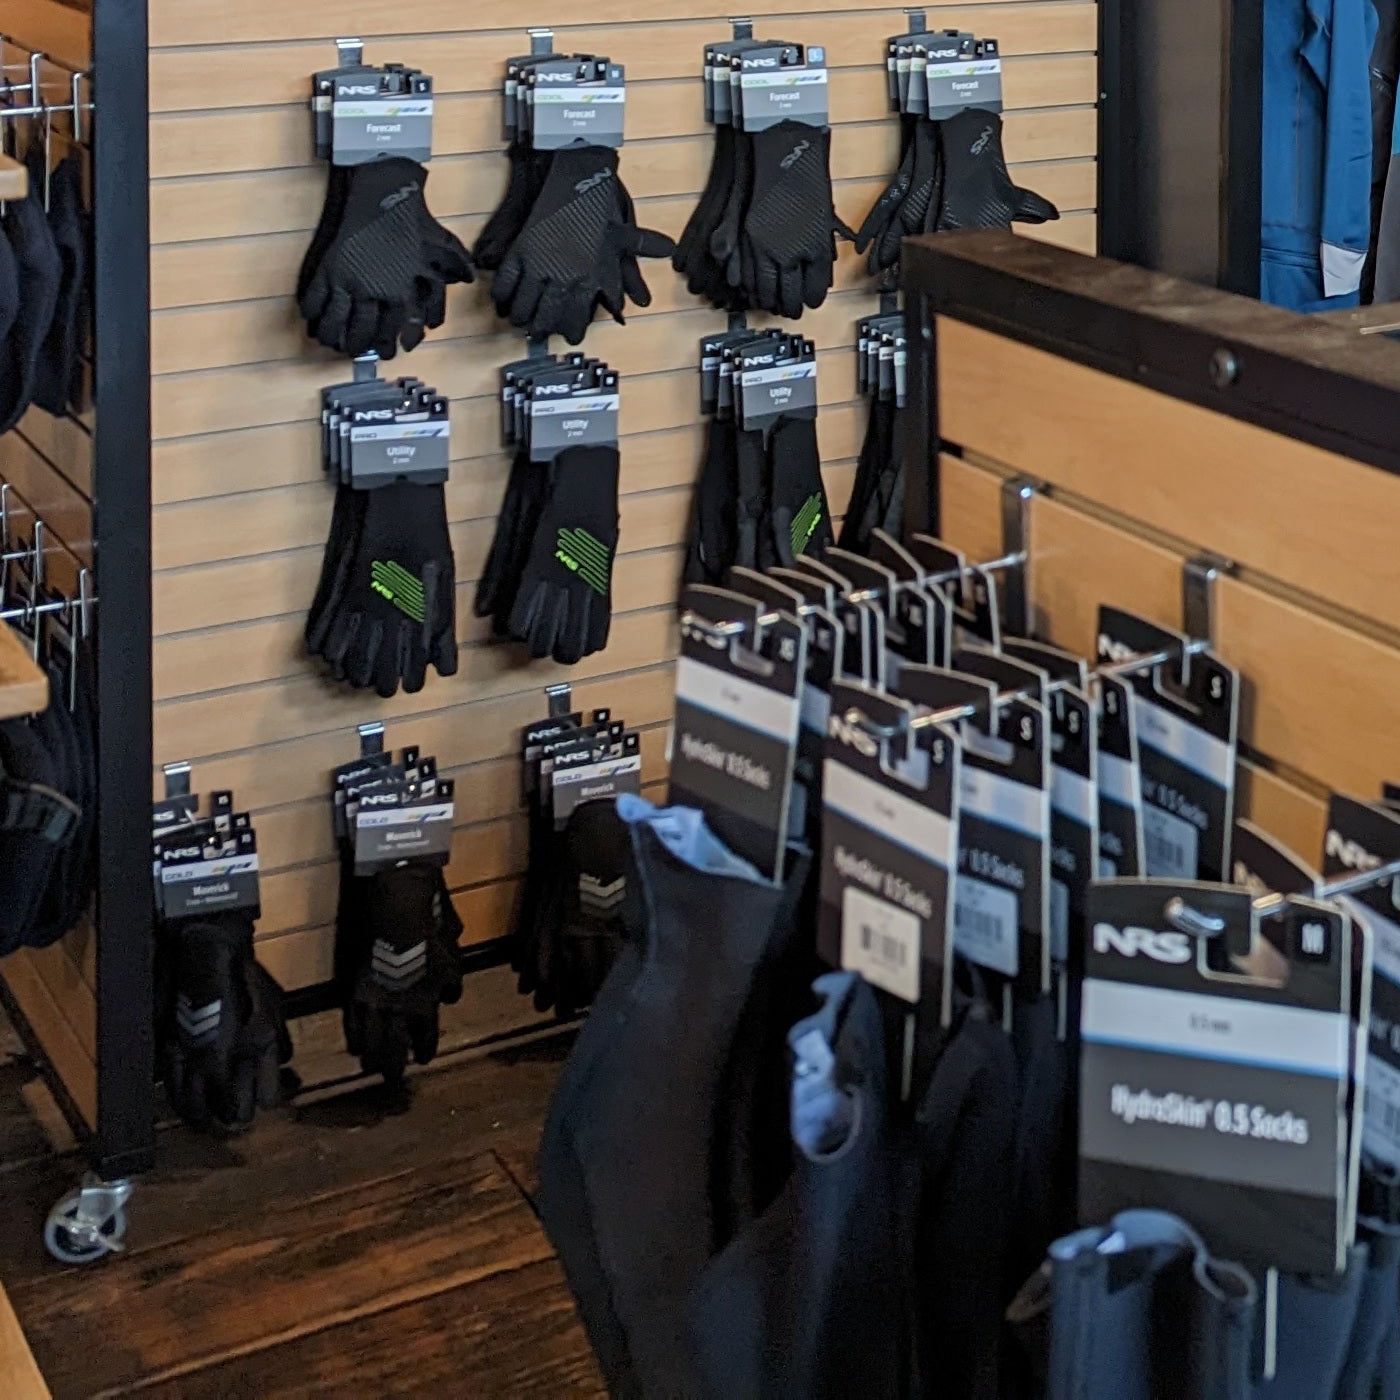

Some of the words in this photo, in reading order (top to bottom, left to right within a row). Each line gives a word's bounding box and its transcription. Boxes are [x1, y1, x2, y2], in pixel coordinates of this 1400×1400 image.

[928, 48, 957, 59] NRS
[743, 57, 776, 68] NRS
[536, 72, 574, 82] NRS
[338, 85, 377, 96] NRS
[952, 81, 979, 90] Forecast
[770, 92, 800, 102] Forecast
[563, 110, 596, 119] Forecast
[366, 124, 401, 133] Forecast
[744, 354, 774, 367] NRS
[535, 384, 570, 395] NRS
[769, 387, 792, 398] Utility
[355, 409, 392, 420] NRS
[562, 419, 589, 430] Utility
[386, 445, 416, 457] Utility
[1020, 715, 1032, 740] S
[555, 751, 590, 764] NRS
[361, 793, 398, 805] NRS
[386, 830, 422, 842] Maverick
[164, 846, 200, 860] NRS
[193, 882, 230, 896] Maverick
[1093, 922, 1191, 963] NRS
[1302, 923, 1325, 954] M
[1214, 1100, 1248, 1135] 0.5
[1249, 1106, 1309, 1144] Socks
